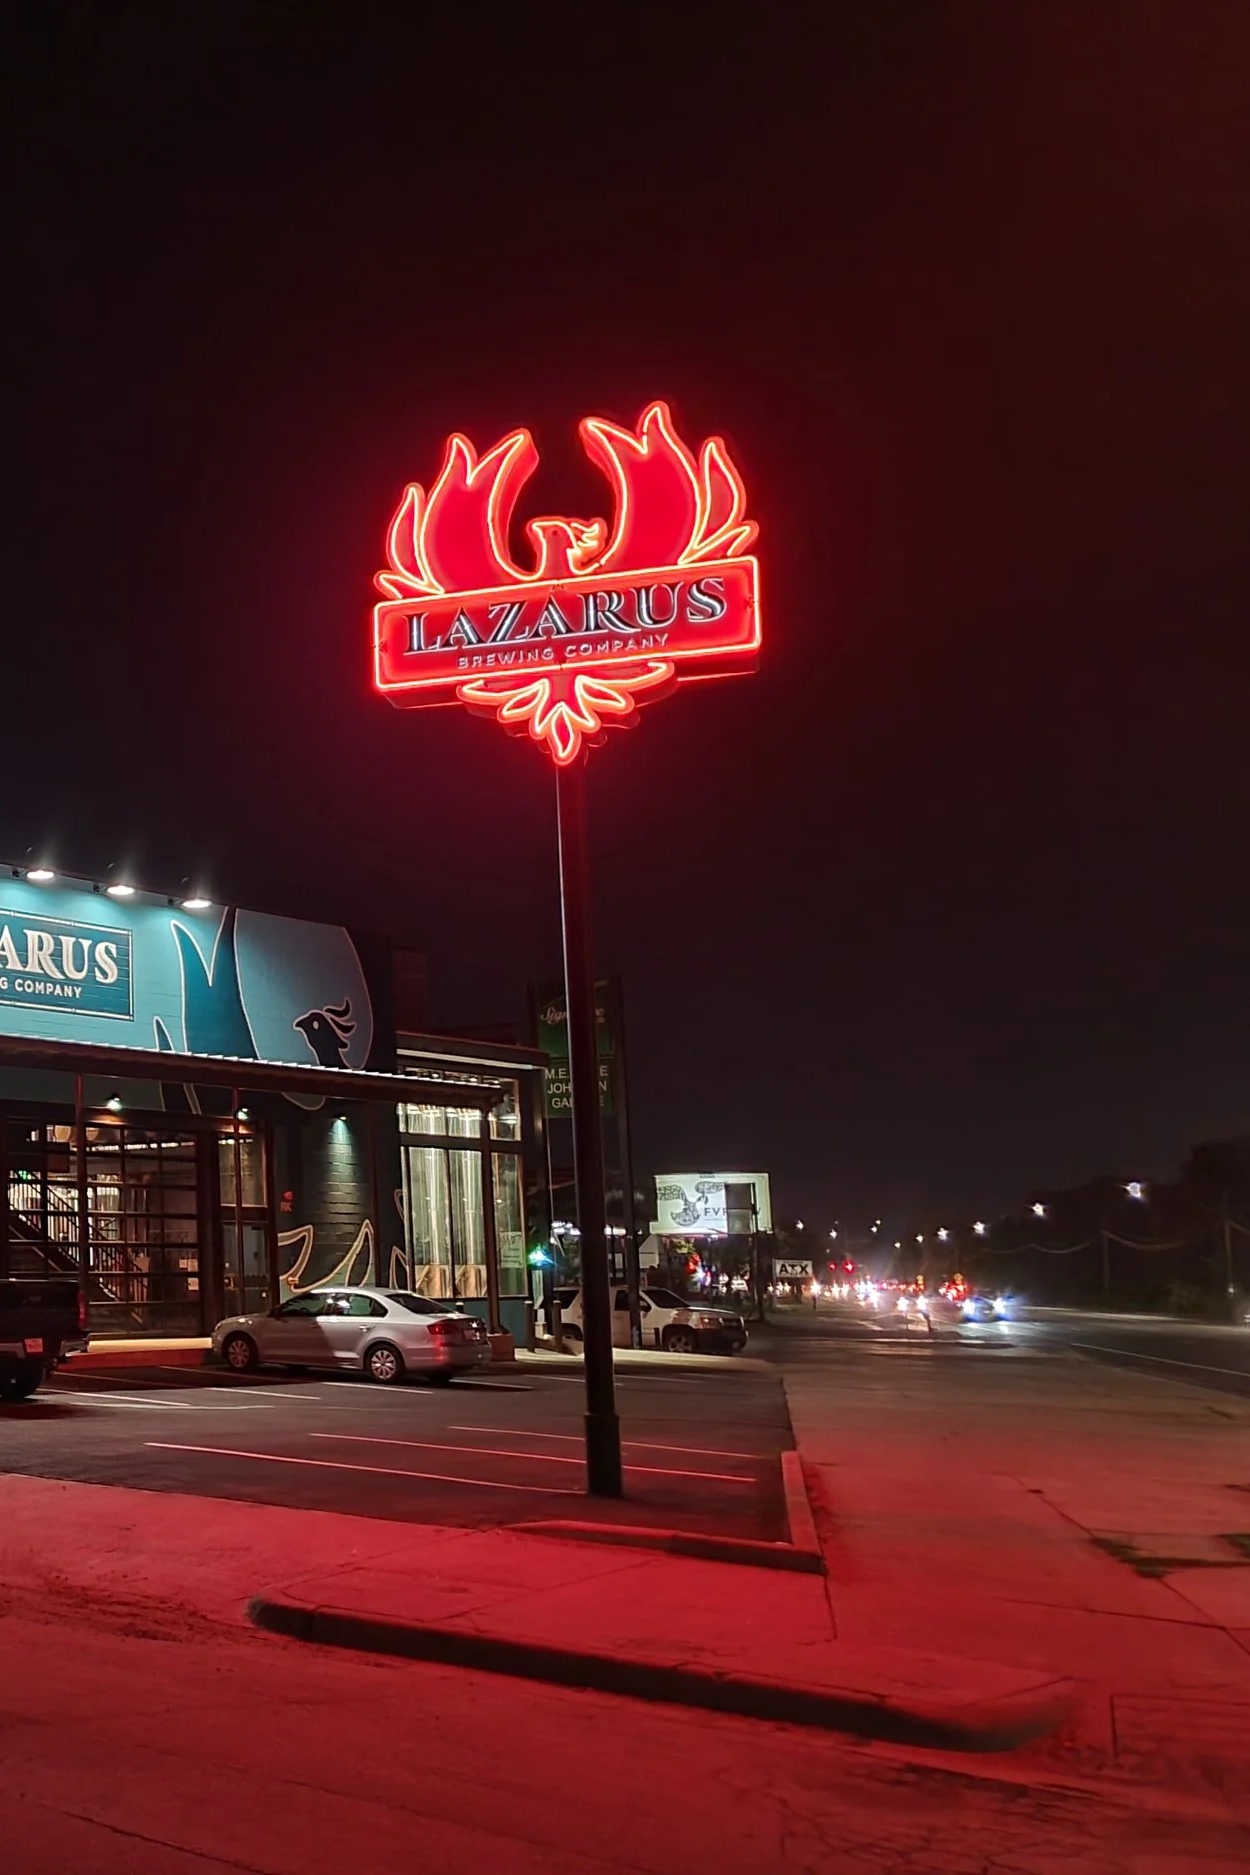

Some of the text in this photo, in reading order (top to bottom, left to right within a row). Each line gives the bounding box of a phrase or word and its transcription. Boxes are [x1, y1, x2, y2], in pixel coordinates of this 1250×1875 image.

[403, 577, 728, 656] LAZARUS
[457, 633, 669, 669] BREWING COMPANY
[14, 979, 82, 999] COMPANY
